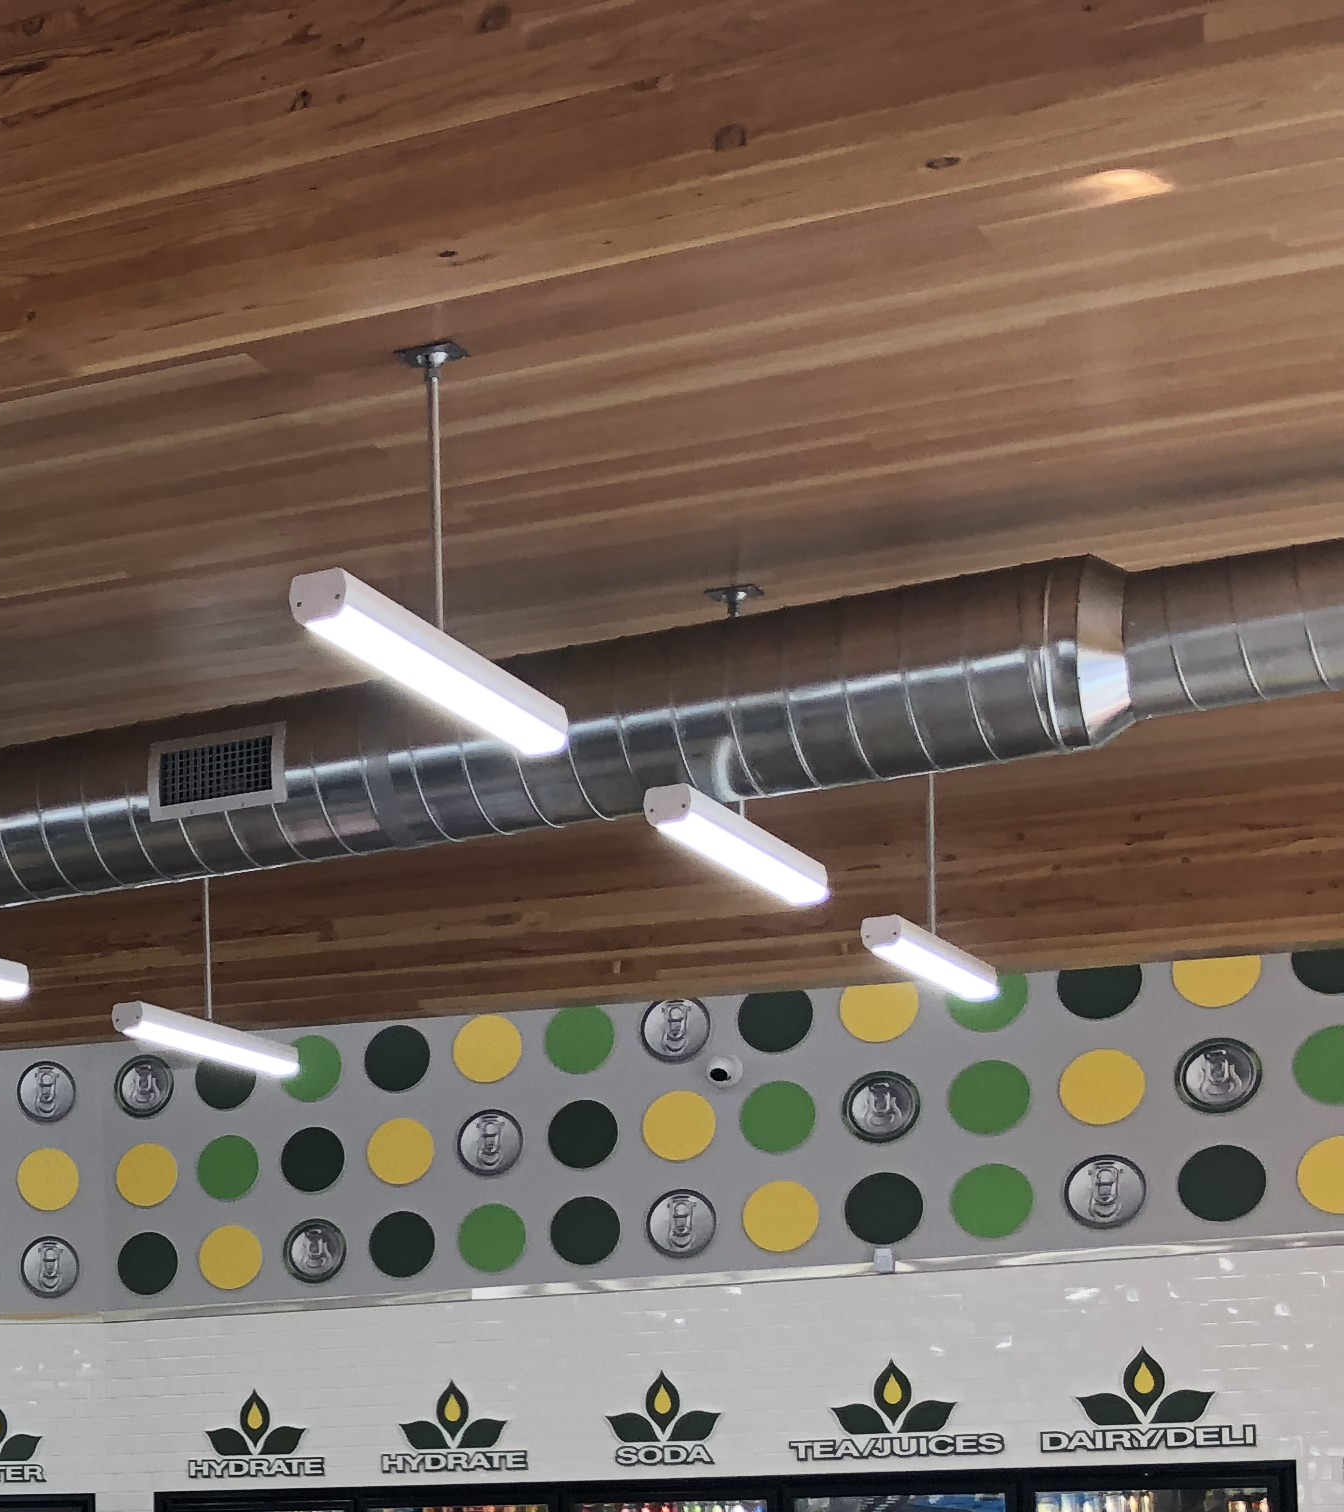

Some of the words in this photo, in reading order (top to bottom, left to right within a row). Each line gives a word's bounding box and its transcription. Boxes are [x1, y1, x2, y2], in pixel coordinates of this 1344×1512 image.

[790, 1433, 1004, 1460] TEA/JUICES
[1040, 1425, 1258, 1453] DAIRY/DELI
[381, 1451, 528, 1473] HYDRATE
[616, 1445, 714, 1466] SODA
[189, 1457, 325, 1477] HYDRATE
